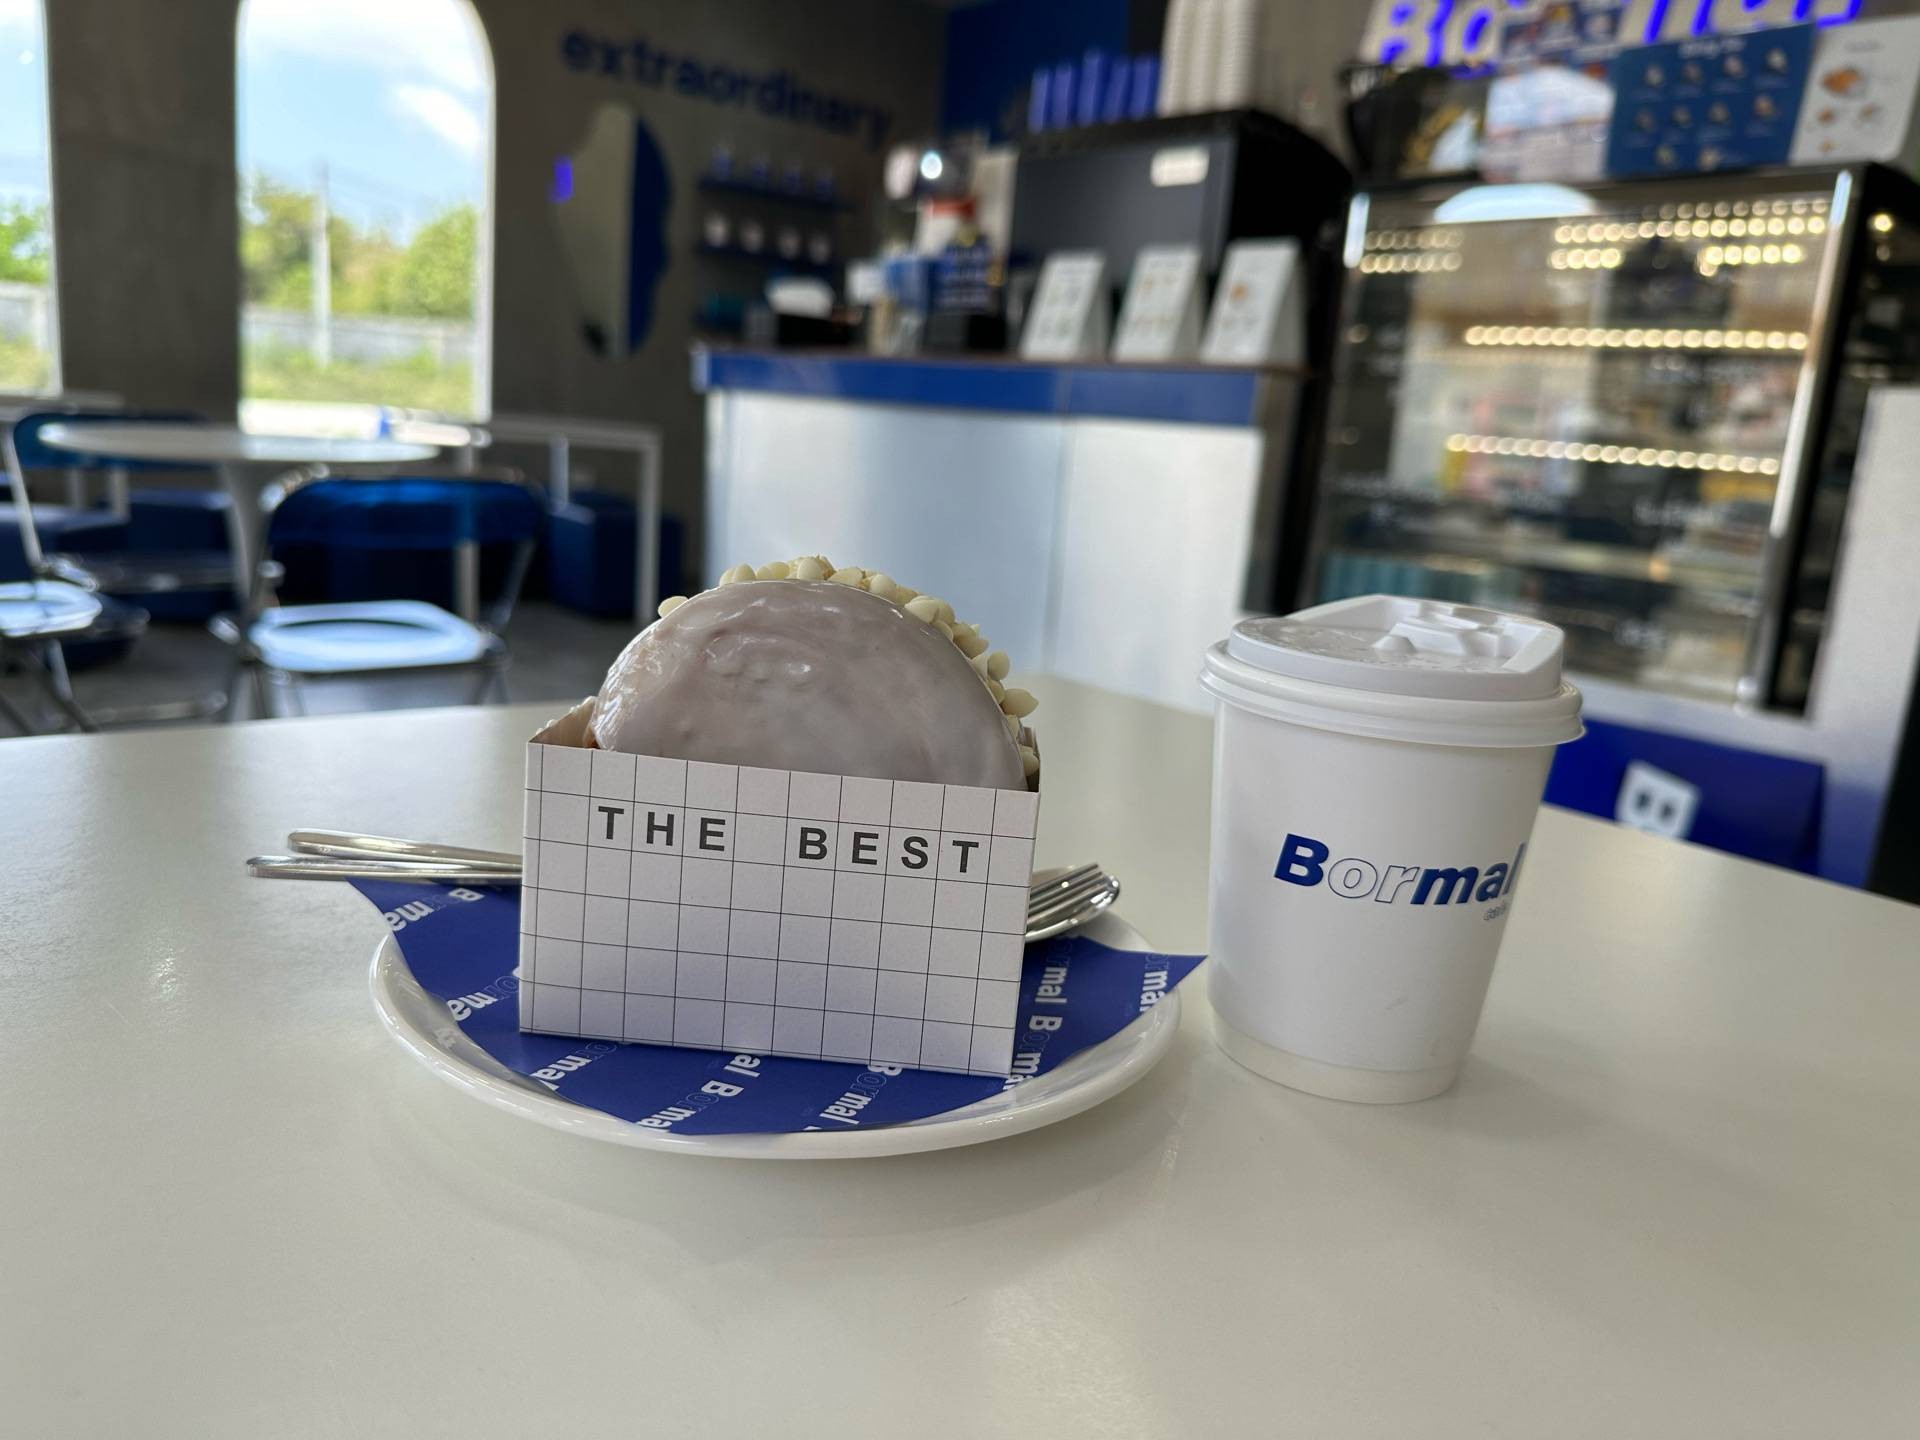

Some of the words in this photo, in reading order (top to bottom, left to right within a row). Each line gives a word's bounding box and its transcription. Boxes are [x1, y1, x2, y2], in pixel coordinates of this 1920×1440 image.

[598, 806, 726, 851] THE
[799, 827, 979, 873] BEST
[1274, 833, 1526, 905] Bormal
[384, 887, 485, 931] Borma
